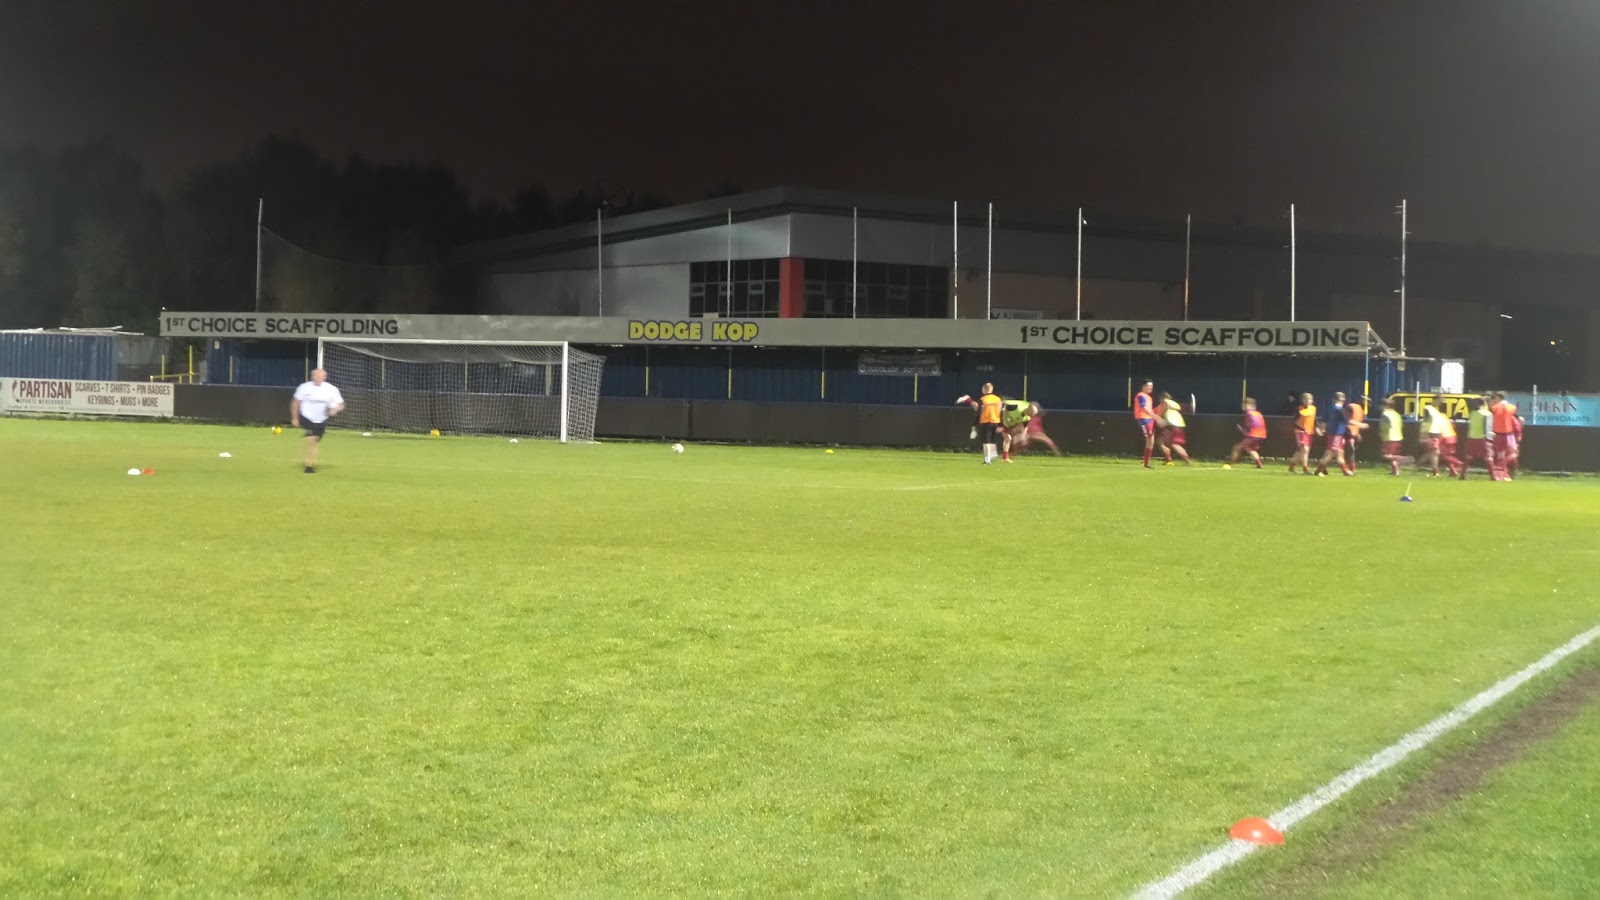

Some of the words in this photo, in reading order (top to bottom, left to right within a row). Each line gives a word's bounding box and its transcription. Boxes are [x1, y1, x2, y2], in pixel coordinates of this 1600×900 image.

[166, 317, 185, 332] 1ST
[188, 317, 257, 333] CHOICE
[265, 318, 399, 334] SCAFFOLDING
[629, 321, 702, 341] DODGE
[712, 321, 758, 341] KOP
[1021, 326, 1048, 343] 1ST
[1053, 326, 1153, 345] CHOICE
[1164, 327, 1360, 347] SCAFFOLDING
[20, 380, 72, 399] PARTISAN
[75, 382, 101, 392] SCARVES
[110, 383, 131, 393] SHIRTS
[136, 384, 147, 394] PIN
[147, 385, 171, 395] BADGES
[87, 395, 115, 405] KEYRINGS
[120, 396, 136, 406] MUGS
[142, 397, 159, 407] MORE
[1404, 397, 1470, 418] DETA
